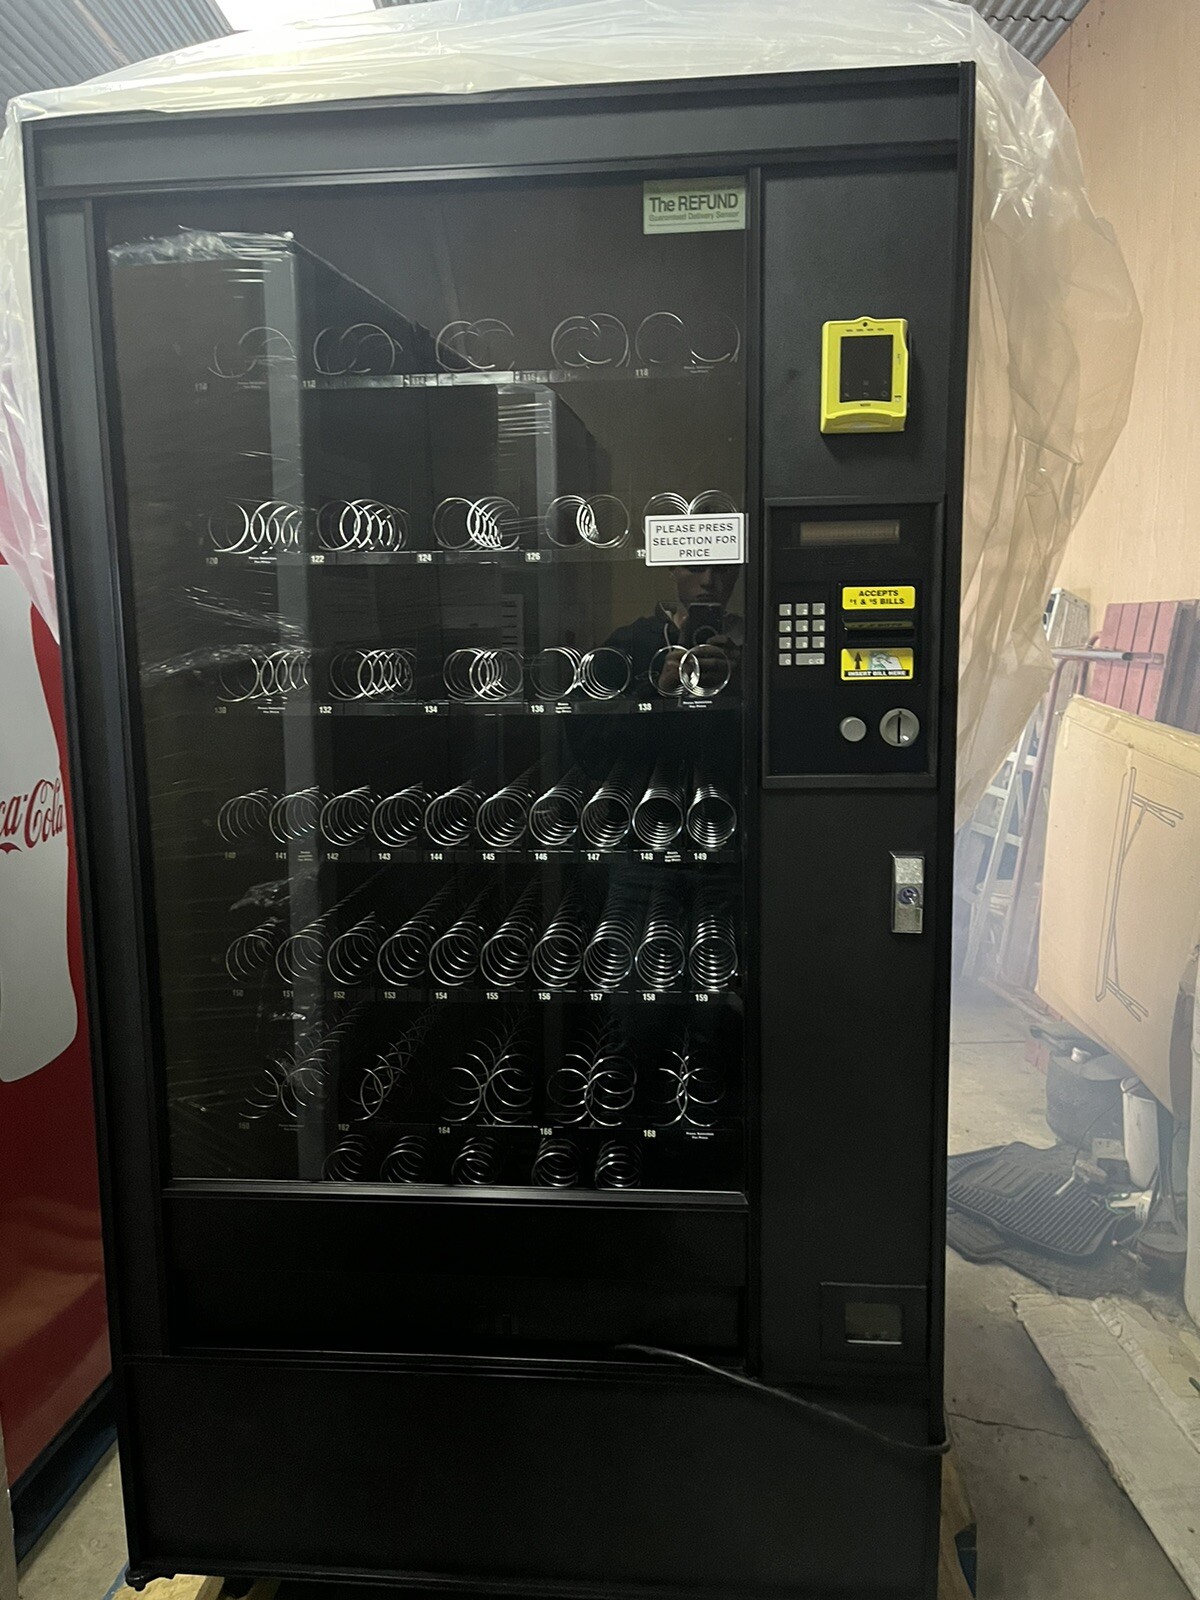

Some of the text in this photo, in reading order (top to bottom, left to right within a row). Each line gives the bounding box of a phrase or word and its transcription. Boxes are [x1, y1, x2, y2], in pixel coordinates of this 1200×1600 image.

[649, 193, 739, 213] The REFUND
[655, 523, 733, 534] PLEASE PRESS
[652, 535, 737, 546] SELECTION FOR
[310, 555, 325, 563] 122
[418, 552, 432, 561] 124
[526, 551, 541, 561] 126
[636, 549, 646, 557] 12
[679, 548, 710, 558] PRICE
[880, 597, 905, 605] BILLS
[319, 705, 333, 714] 132
[424, 704, 438, 713] 134
[530, 704, 545, 713] 136
[638, 702, 653, 711] 138
[275, 851, 287, 859] 141
[326, 852, 339, 860] 142
[378, 852, 391, 860] 143
[430, 852, 443, 860] 144
[482, 852, 495, 861] 145
[534, 852, 548, 861] 146
[587, 852, 600, 861] 147
[640, 852, 654, 861] 148
[694, 852, 708, 861] 149
[282, 989, 294, 998] 151
[333, 991, 346, 999] 152
[384, 991, 397, 1000] 153
[435, 991, 448, 1000] 154
[486, 992, 499, 1000] 155
[538, 992, 552, 1000] 156
[590, 992, 603, 1001] 157
[642, 993, 656, 1002] 158
[695, 993, 709, 1002] 159
[438, 1126, 451, 1134] 164
[540, 1127, 553, 1136] 166
[643, 1129, 657, 1138] 168
